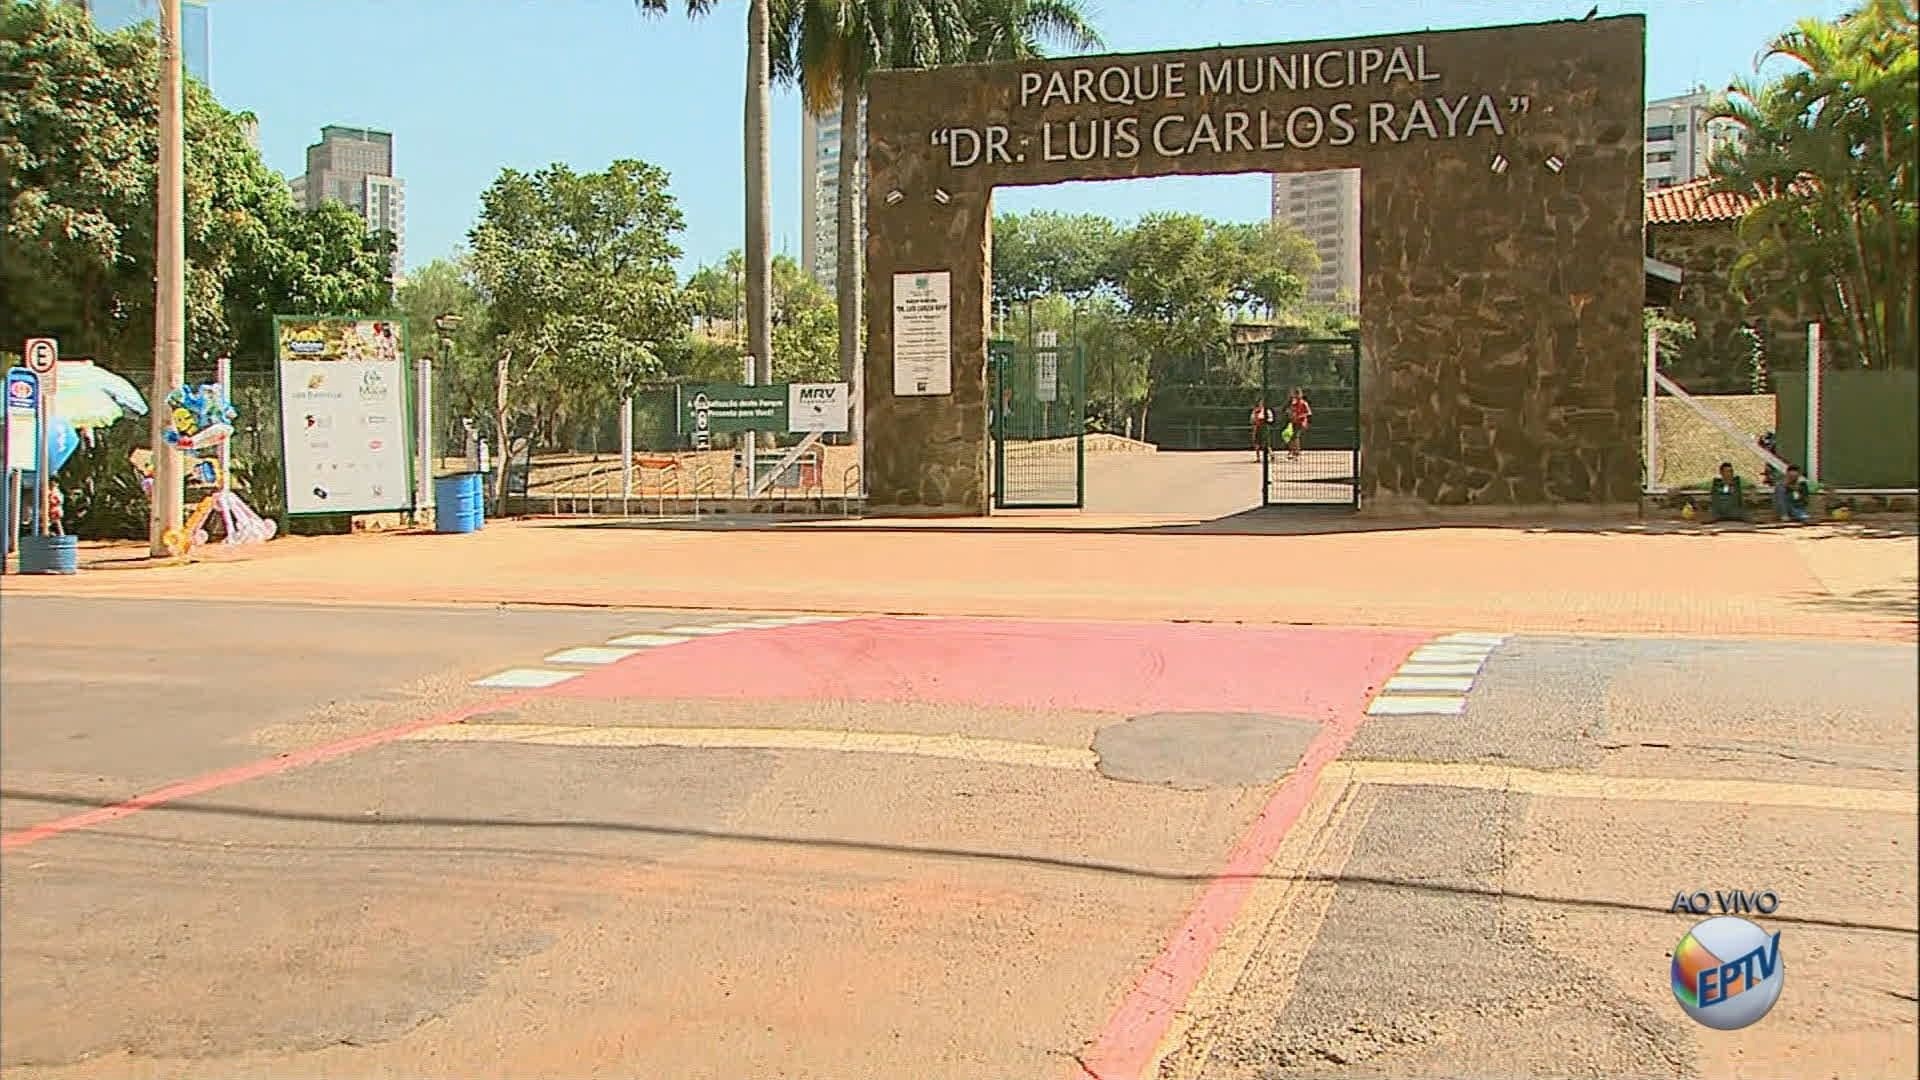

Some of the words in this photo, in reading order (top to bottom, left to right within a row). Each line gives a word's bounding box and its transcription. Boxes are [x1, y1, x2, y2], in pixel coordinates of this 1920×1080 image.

[1019, 62, 1187, 107] PARQUE
[1199, 44, 1441, 97] MUNICIPAL
[1042, 117, 1142, 162] LUIS
[1152, 102, 1356, 158] CARLOS
[37, 346, 47, 367] E
[800, 388, 836, 399] MRV
